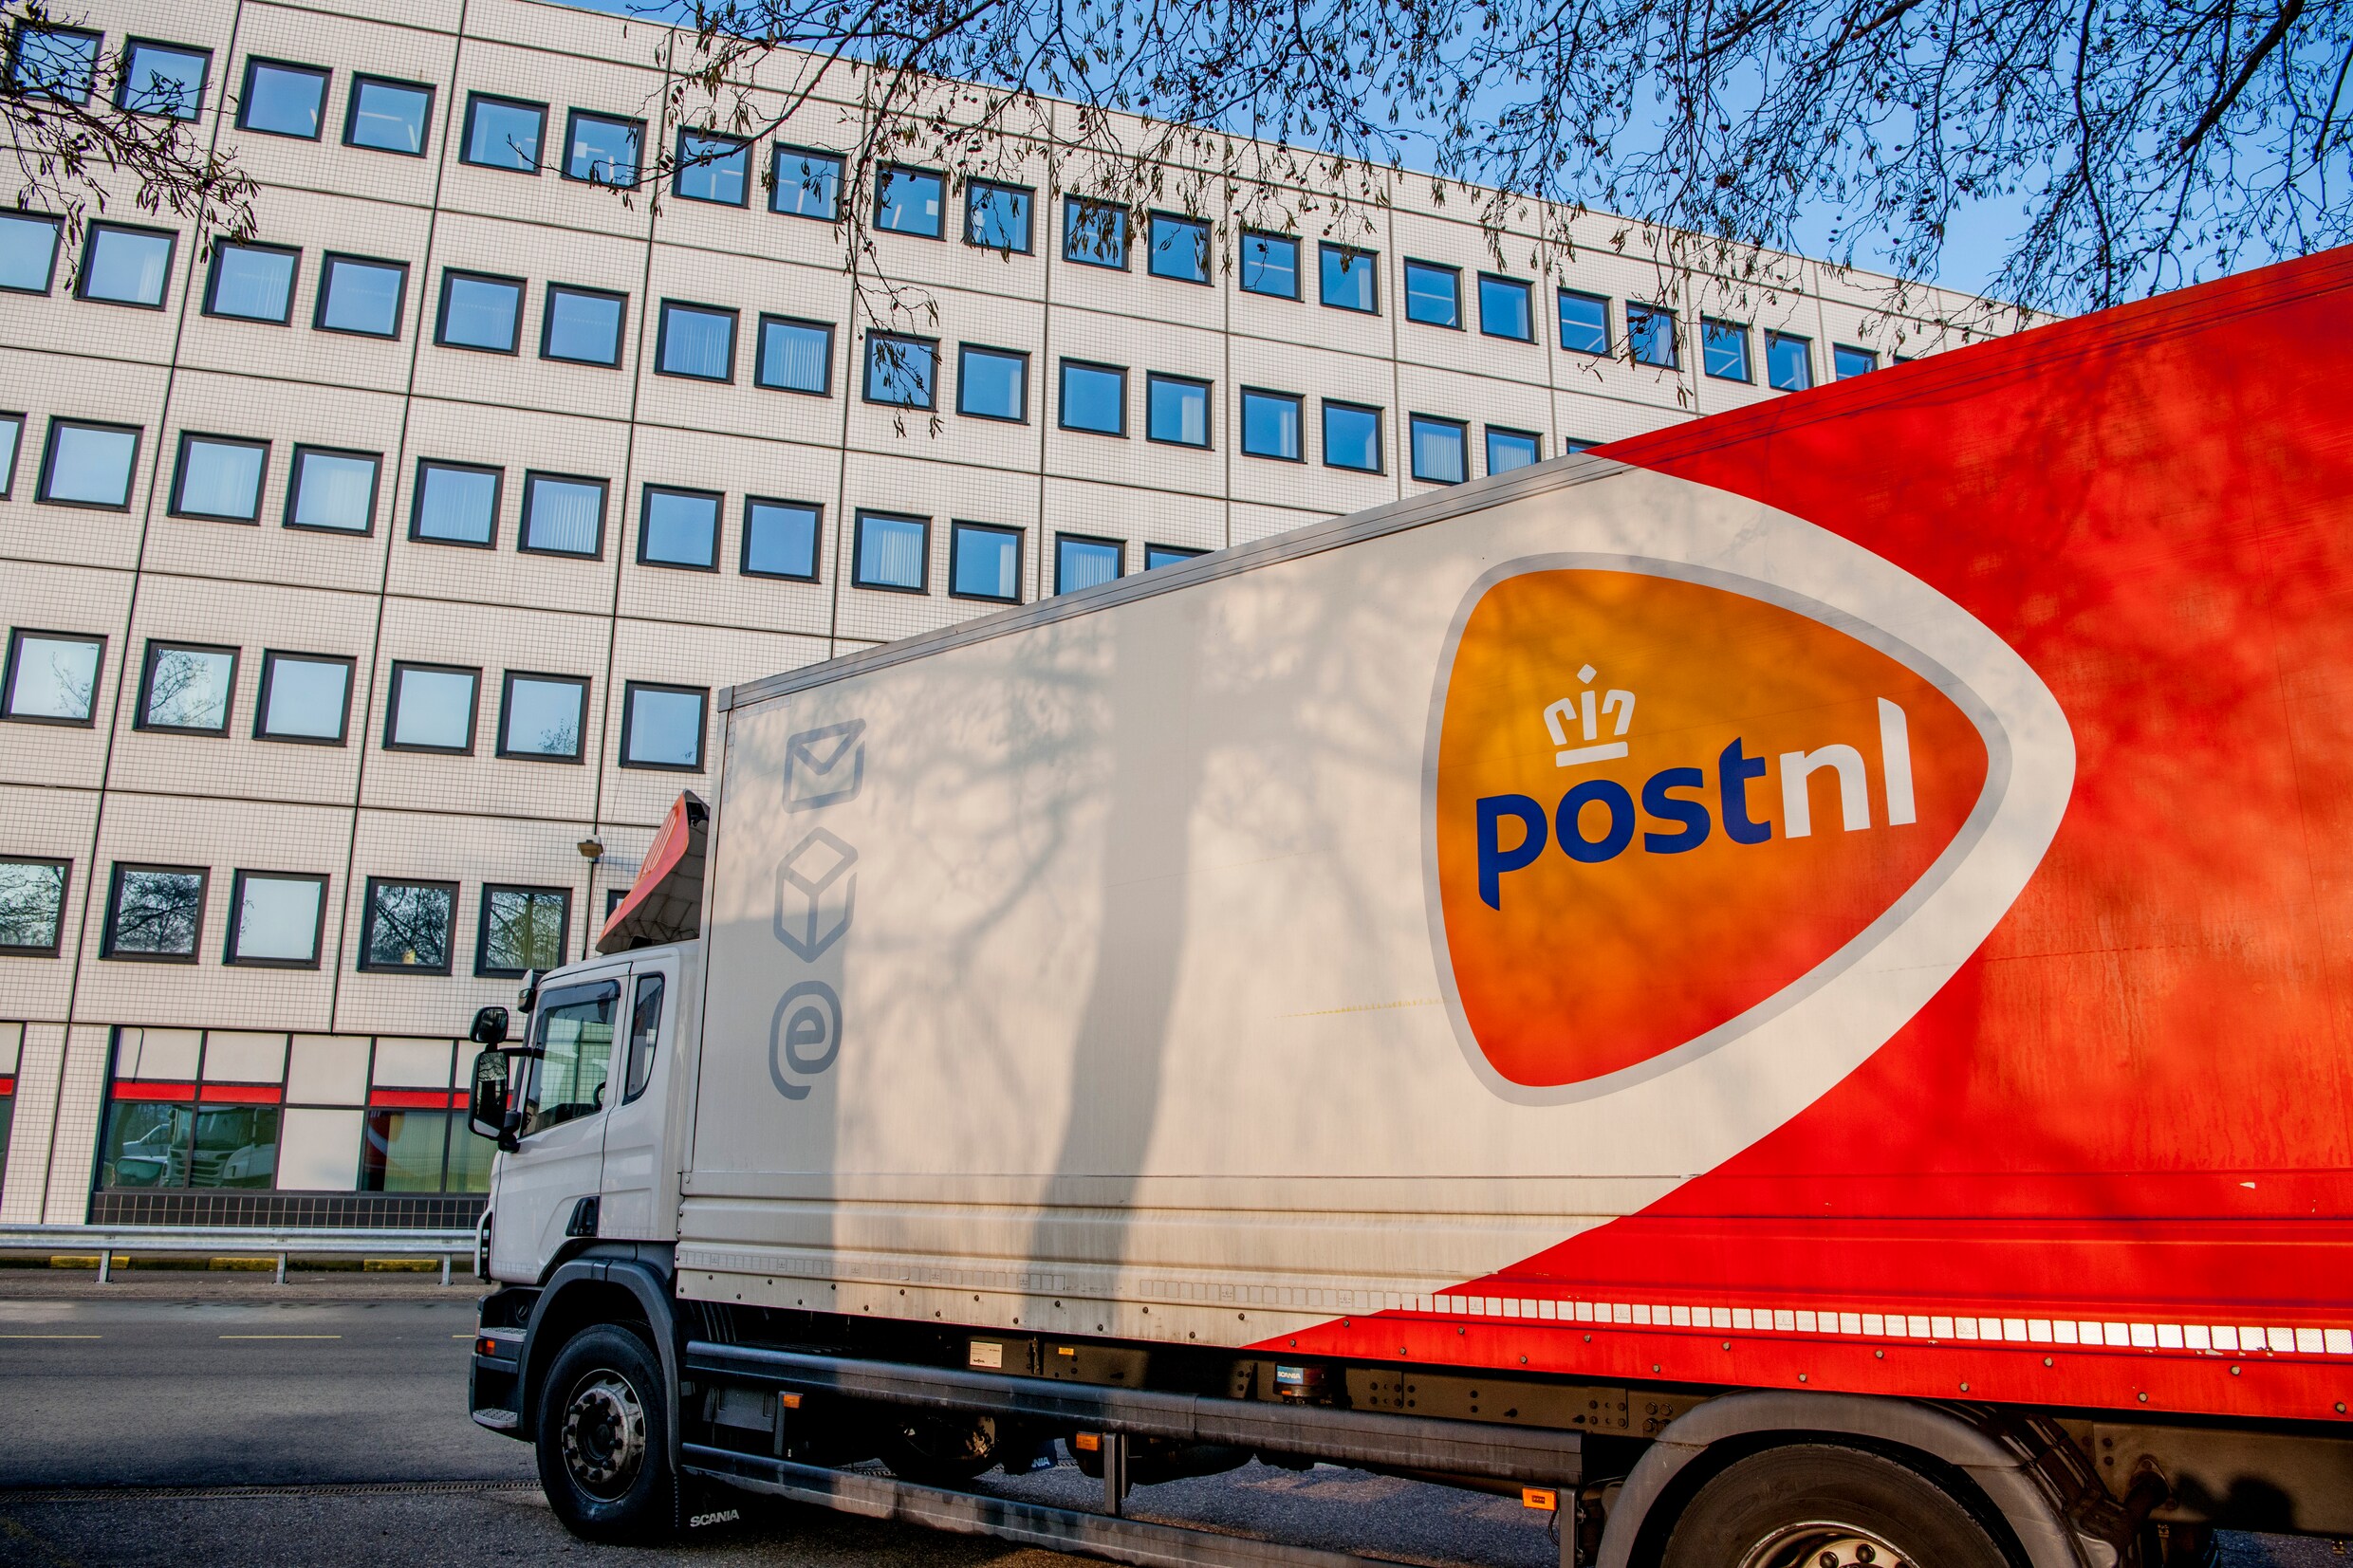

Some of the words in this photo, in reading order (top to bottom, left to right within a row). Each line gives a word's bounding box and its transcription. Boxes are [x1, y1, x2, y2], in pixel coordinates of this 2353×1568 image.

[1476, 697, 1917, 911] postnl
[1277, 1371, 1301, 1379] SCANIA
[690, 1509, 740, 1527] SCANIA
